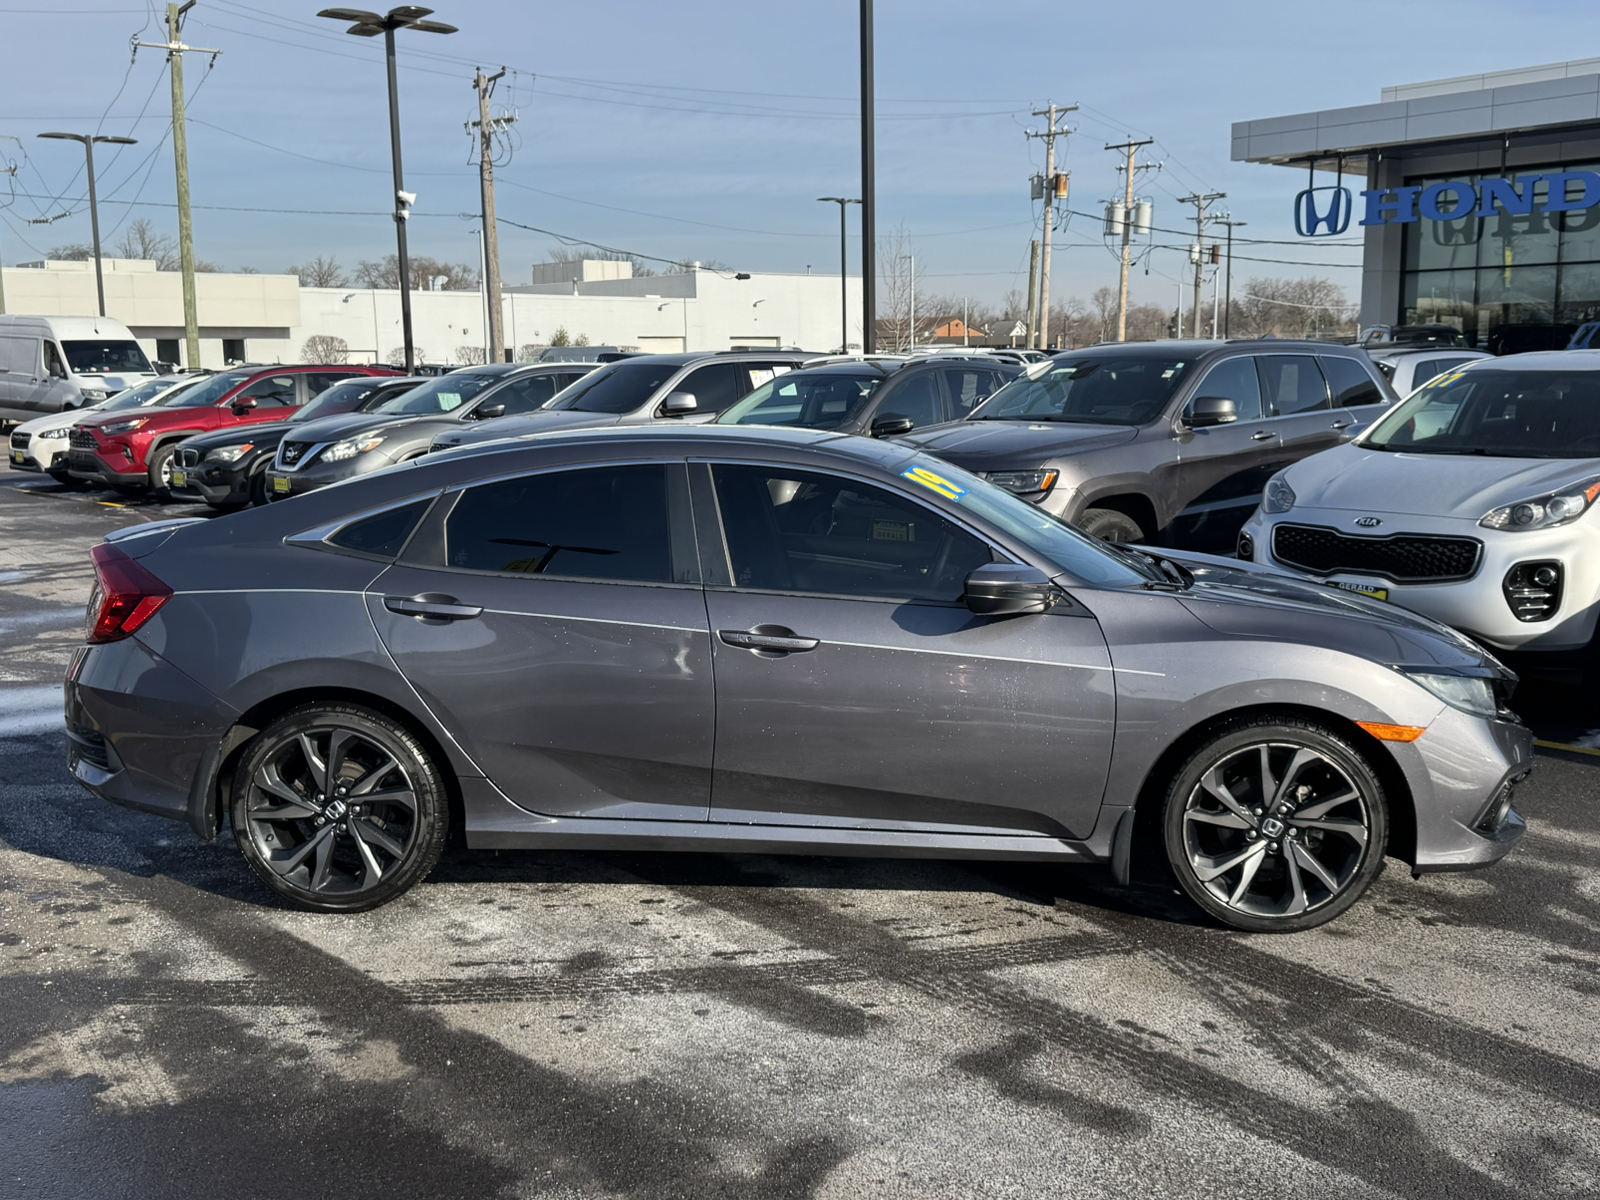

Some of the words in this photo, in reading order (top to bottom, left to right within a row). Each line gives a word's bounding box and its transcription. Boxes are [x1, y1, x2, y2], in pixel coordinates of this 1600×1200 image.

[903, 467, 965, 499] 19
[1358, 518, 1377, 526] KIA
[1338, 582, 1375, 593] GERALD
